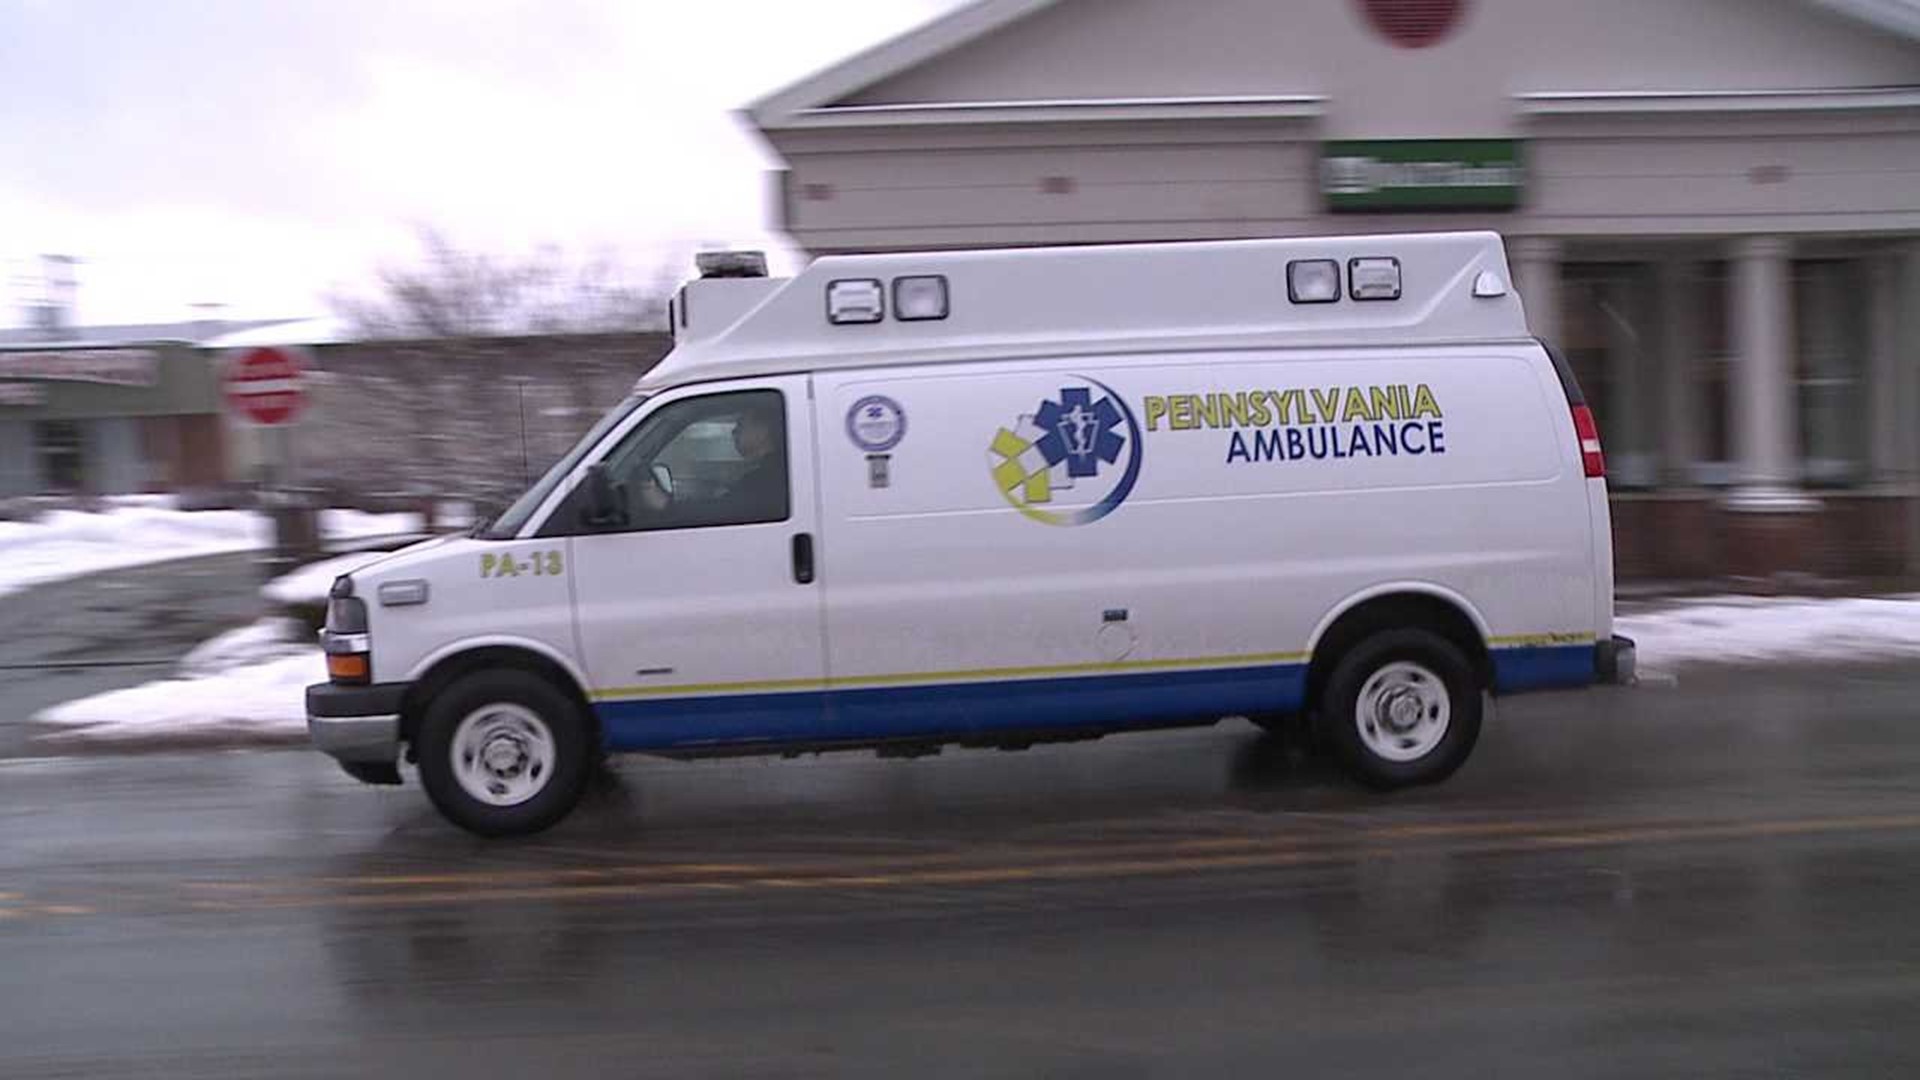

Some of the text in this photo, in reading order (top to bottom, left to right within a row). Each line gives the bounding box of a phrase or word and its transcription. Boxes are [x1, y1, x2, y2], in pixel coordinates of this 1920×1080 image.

[1144, 384, 1442, 431] PENNSYLVANIA
[1226, 422, 1446, 463] AMBULANCE
[479, 551, 564, 578] PA-13
